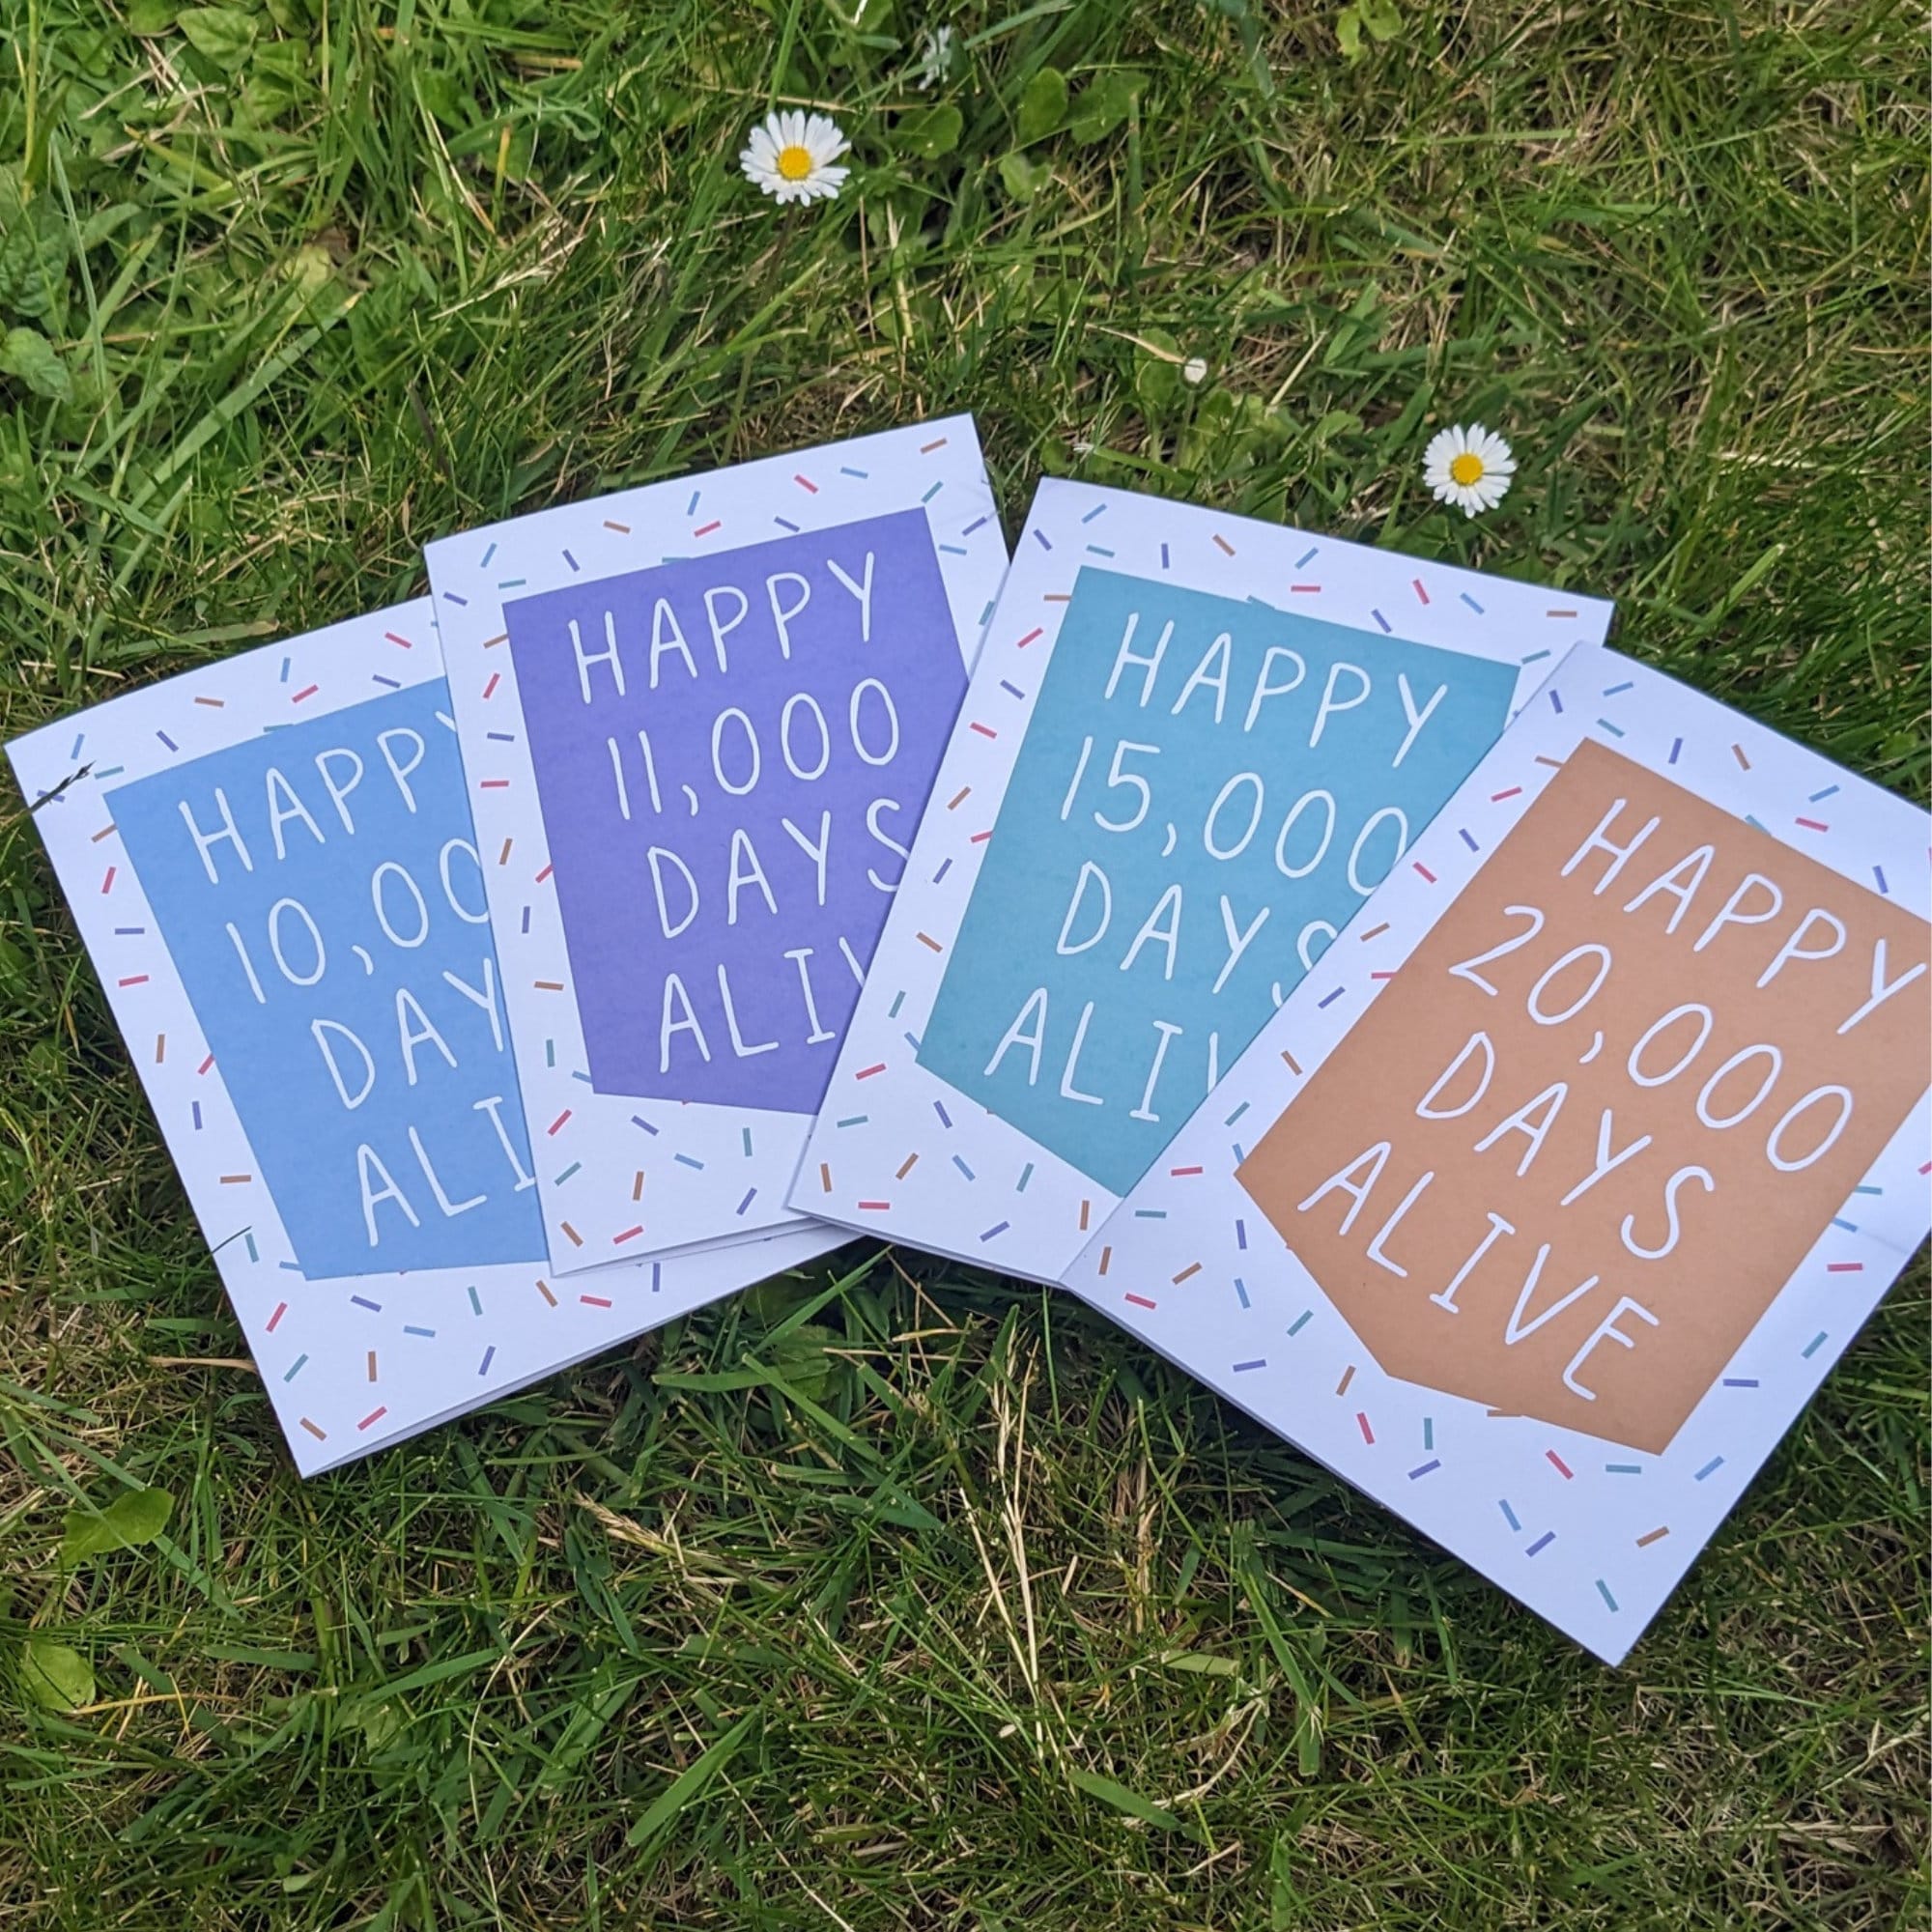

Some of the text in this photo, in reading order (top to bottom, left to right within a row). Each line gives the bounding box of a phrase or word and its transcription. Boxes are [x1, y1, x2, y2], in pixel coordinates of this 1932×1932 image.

[568, 551, 874, 704] HAPPY
[1104, 611, 1447, 768] HAPPY
[179, 711, 457, 884] HAPP
[609, 677, 898, 820] 11,000
[1061, 736, 1408, 896] 15,000
[648, 799, 911, 939] DAYS
[1560, 799, 1927, 1035] HAPPY
[311, 958, 503, 1109] DAY
[1449, 905, 1853, 1172] 20,000
[356, 1096, 535, 1246] ALI
[1415, 1031, 1715, 1260] DAYS
[1296, 1142, 1660, 1400] ALIVE
